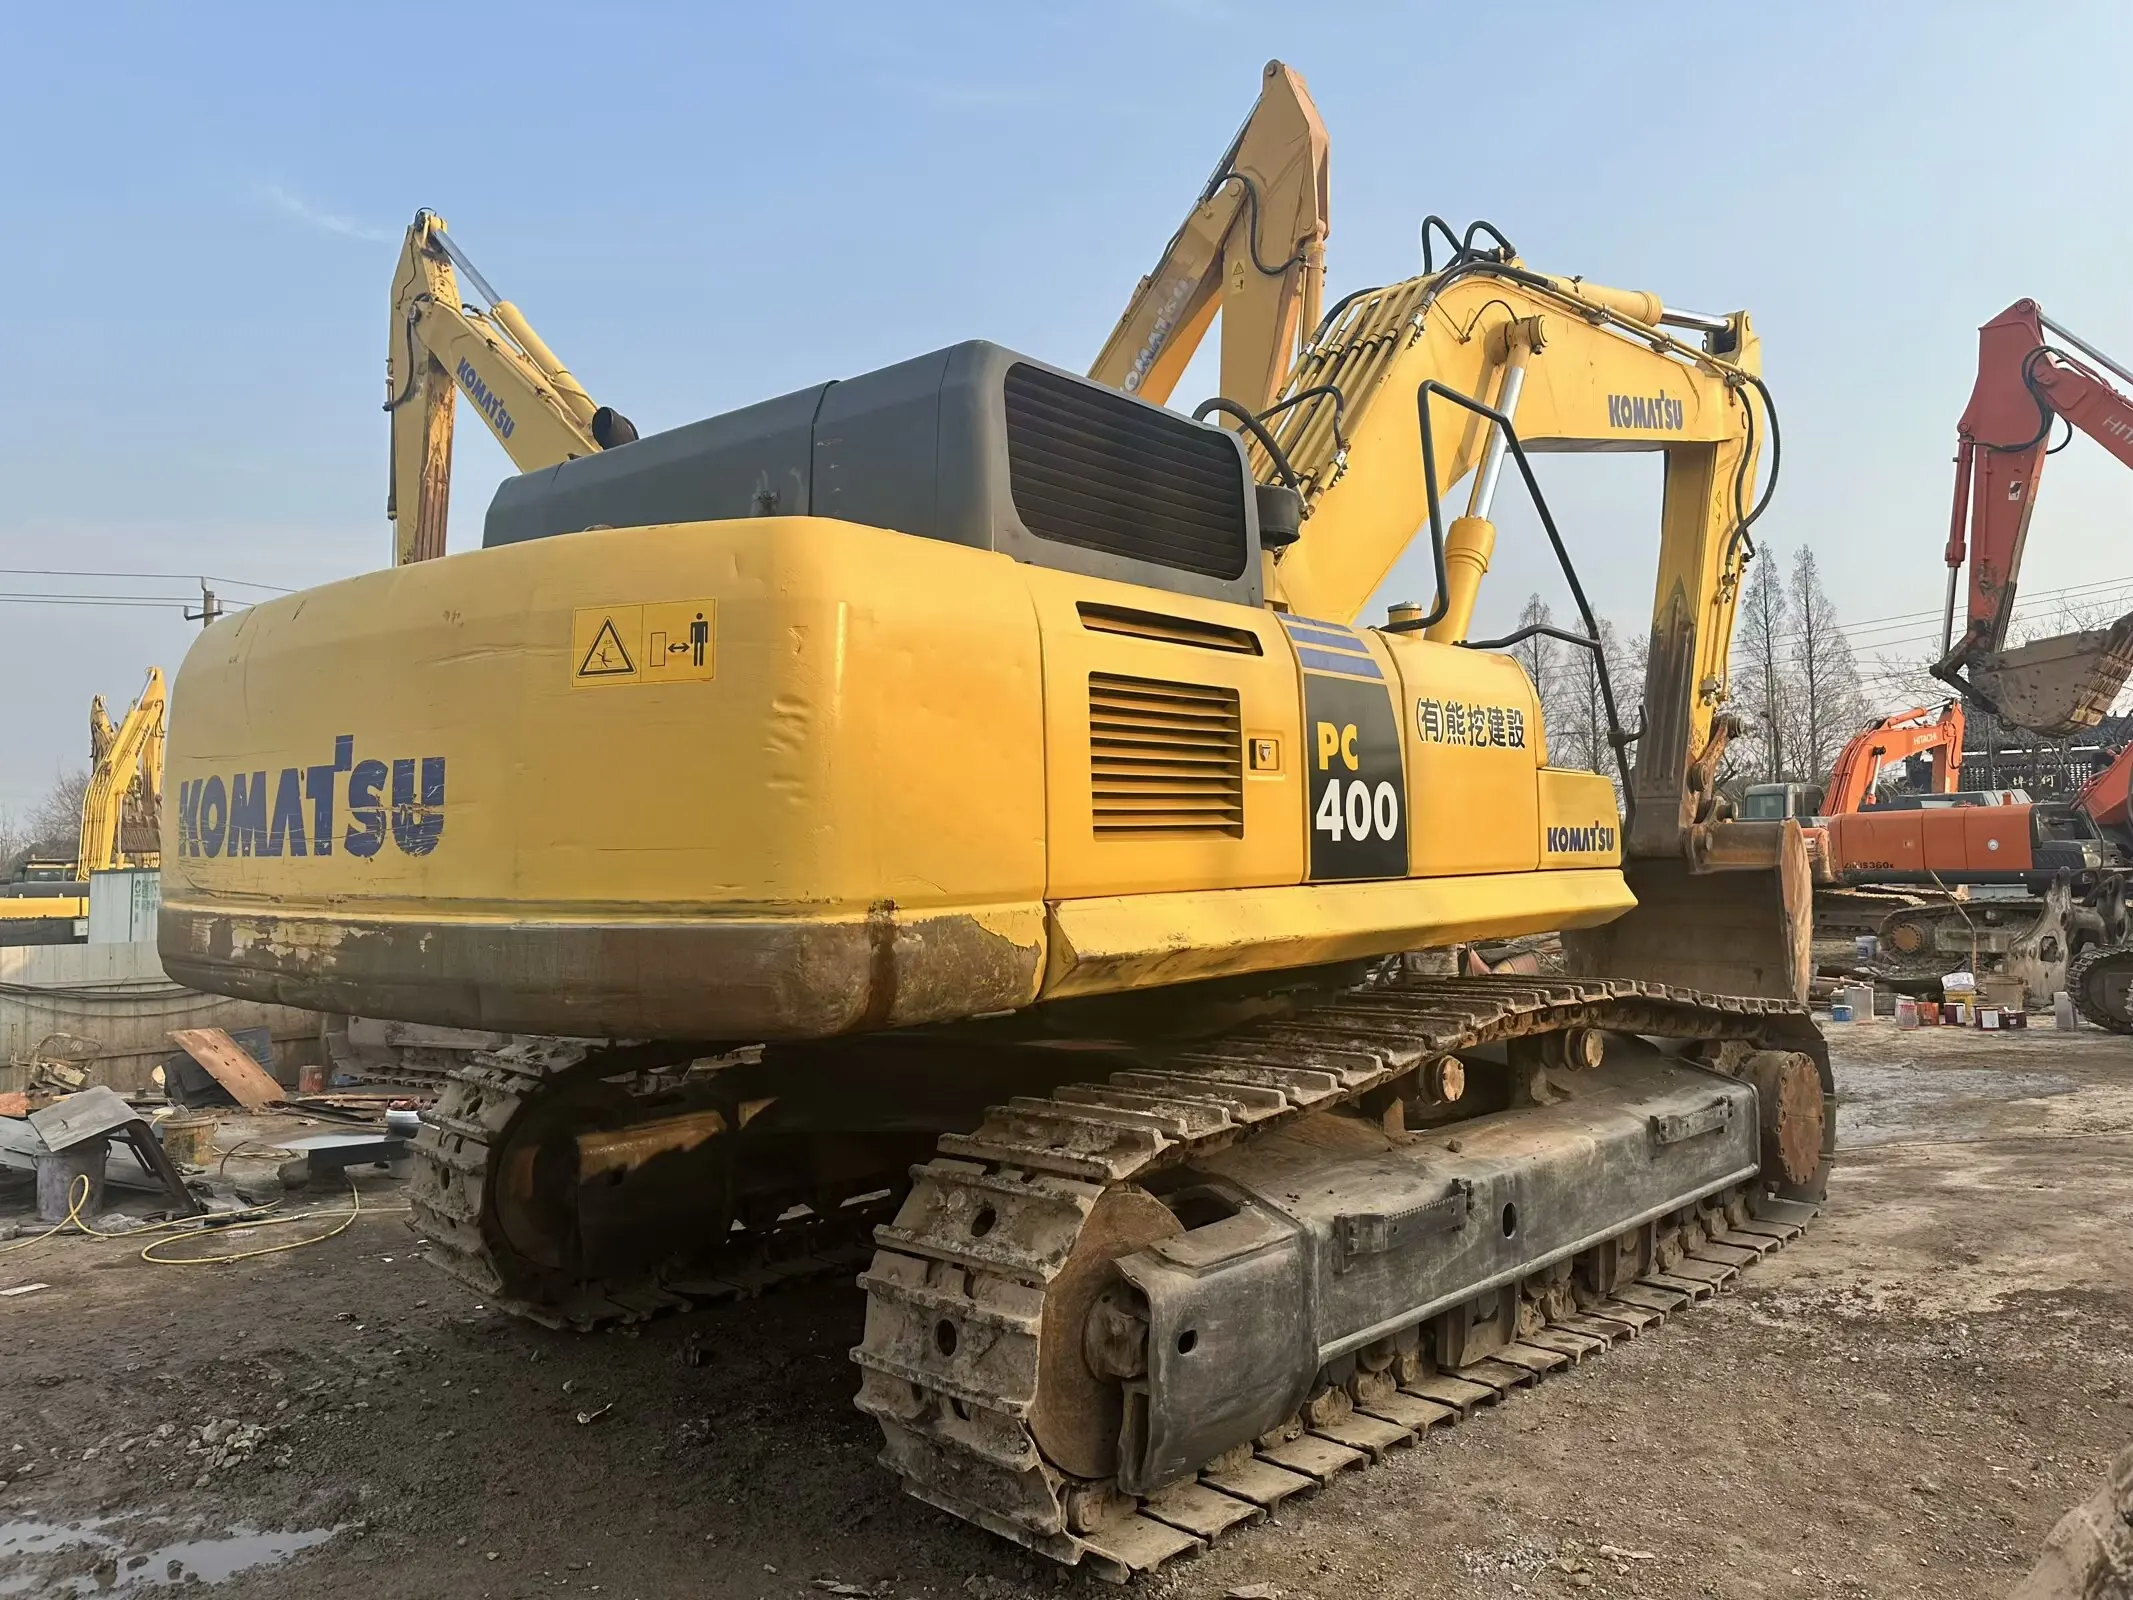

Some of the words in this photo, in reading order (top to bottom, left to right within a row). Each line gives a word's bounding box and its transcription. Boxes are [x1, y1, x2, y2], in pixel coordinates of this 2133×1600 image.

[1120, 281, 1189, 392] OMATSU
[456, 355, 516, 440] KOMATSU
[1607, 389, 1683, 431] KOMATSU
[2102, 416, 2133, 445] HIT
[1316, 721, 1359, 772] PC
[178, 734, 446, 858] KOMATSU
[1315, 778, 1399, 842] 400
[1547, 820, 1615, 852] KOMATSU
